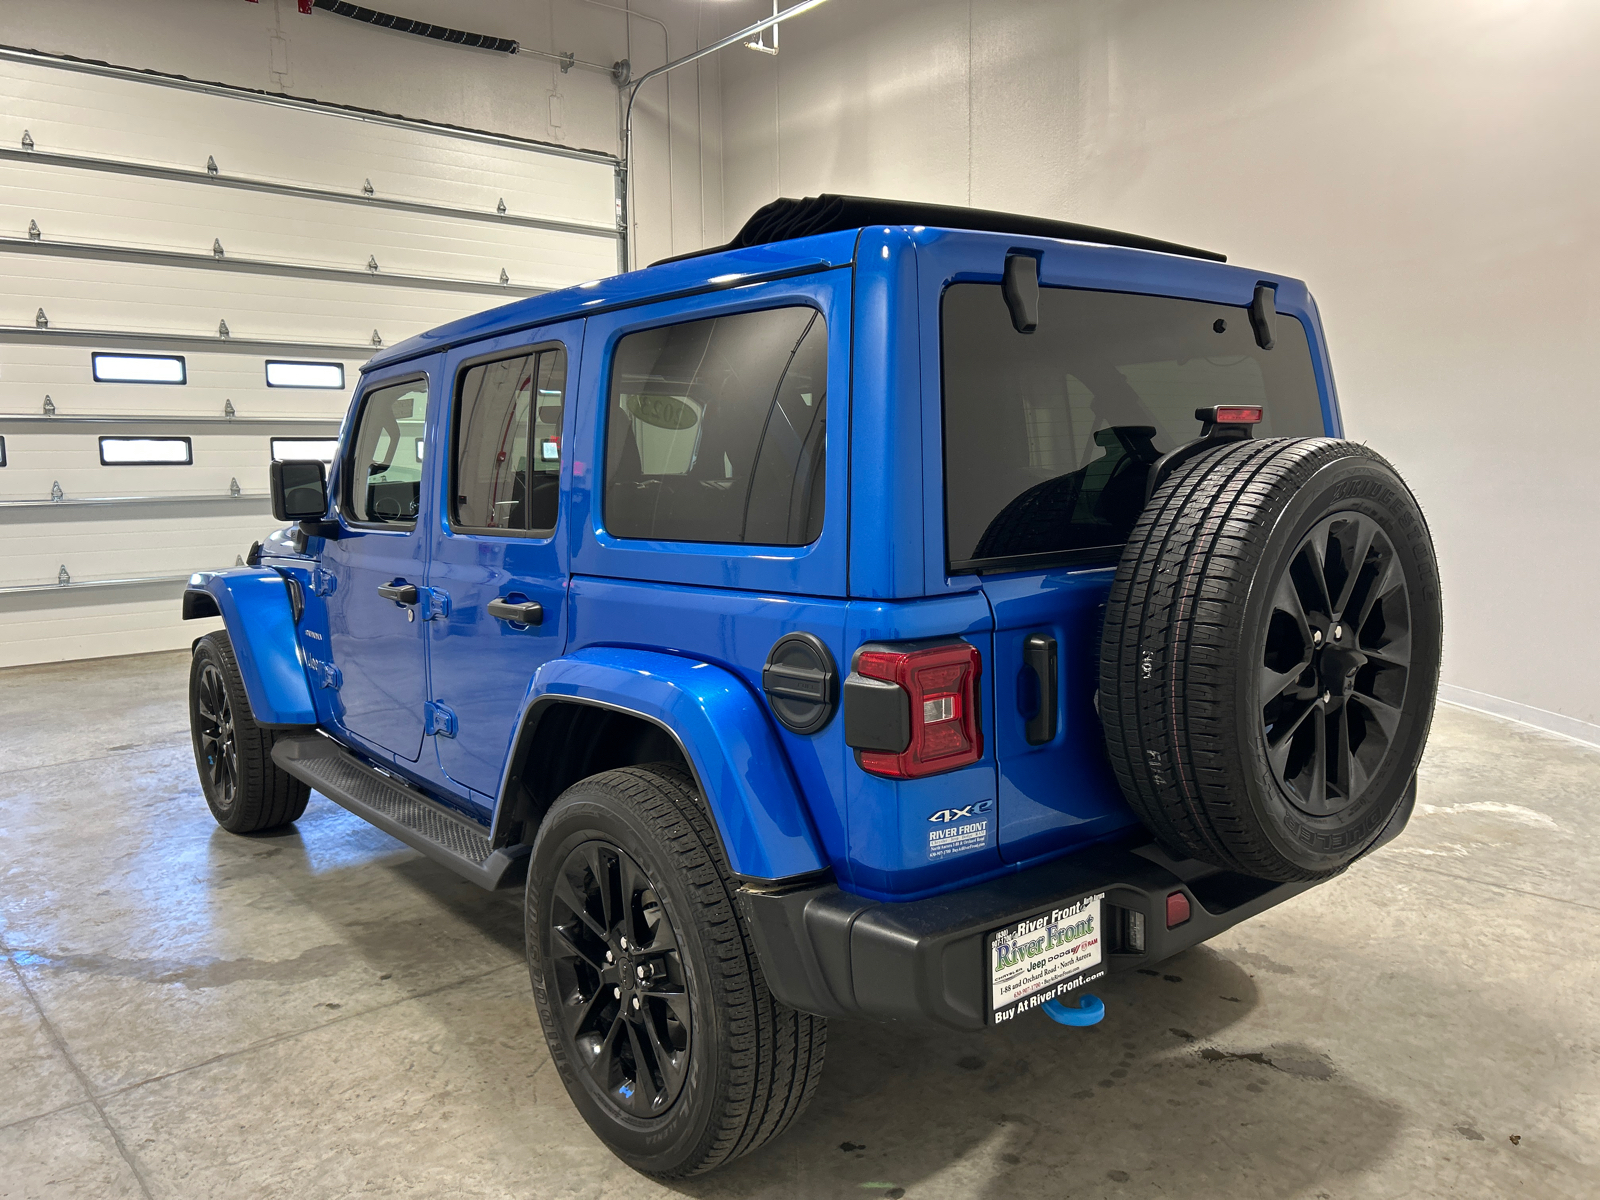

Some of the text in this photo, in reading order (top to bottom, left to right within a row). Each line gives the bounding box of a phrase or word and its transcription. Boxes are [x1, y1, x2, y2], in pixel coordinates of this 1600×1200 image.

[929, 820, 988, 841] RIVER FRONT
[1283, 806, 1383, 850] DUELER
[1018, 901, 1081, 937] River Front
[995, 914, 1094, 973] River Front
[1087, 938, 1098, 947] RAM
[1000, 952, 1092, 996] I-88 and Orchard Road North Aurora
[1026, 958, 1047, 973] Jeep
[994, 970, 1105, 1024] Buy At River Front.com
